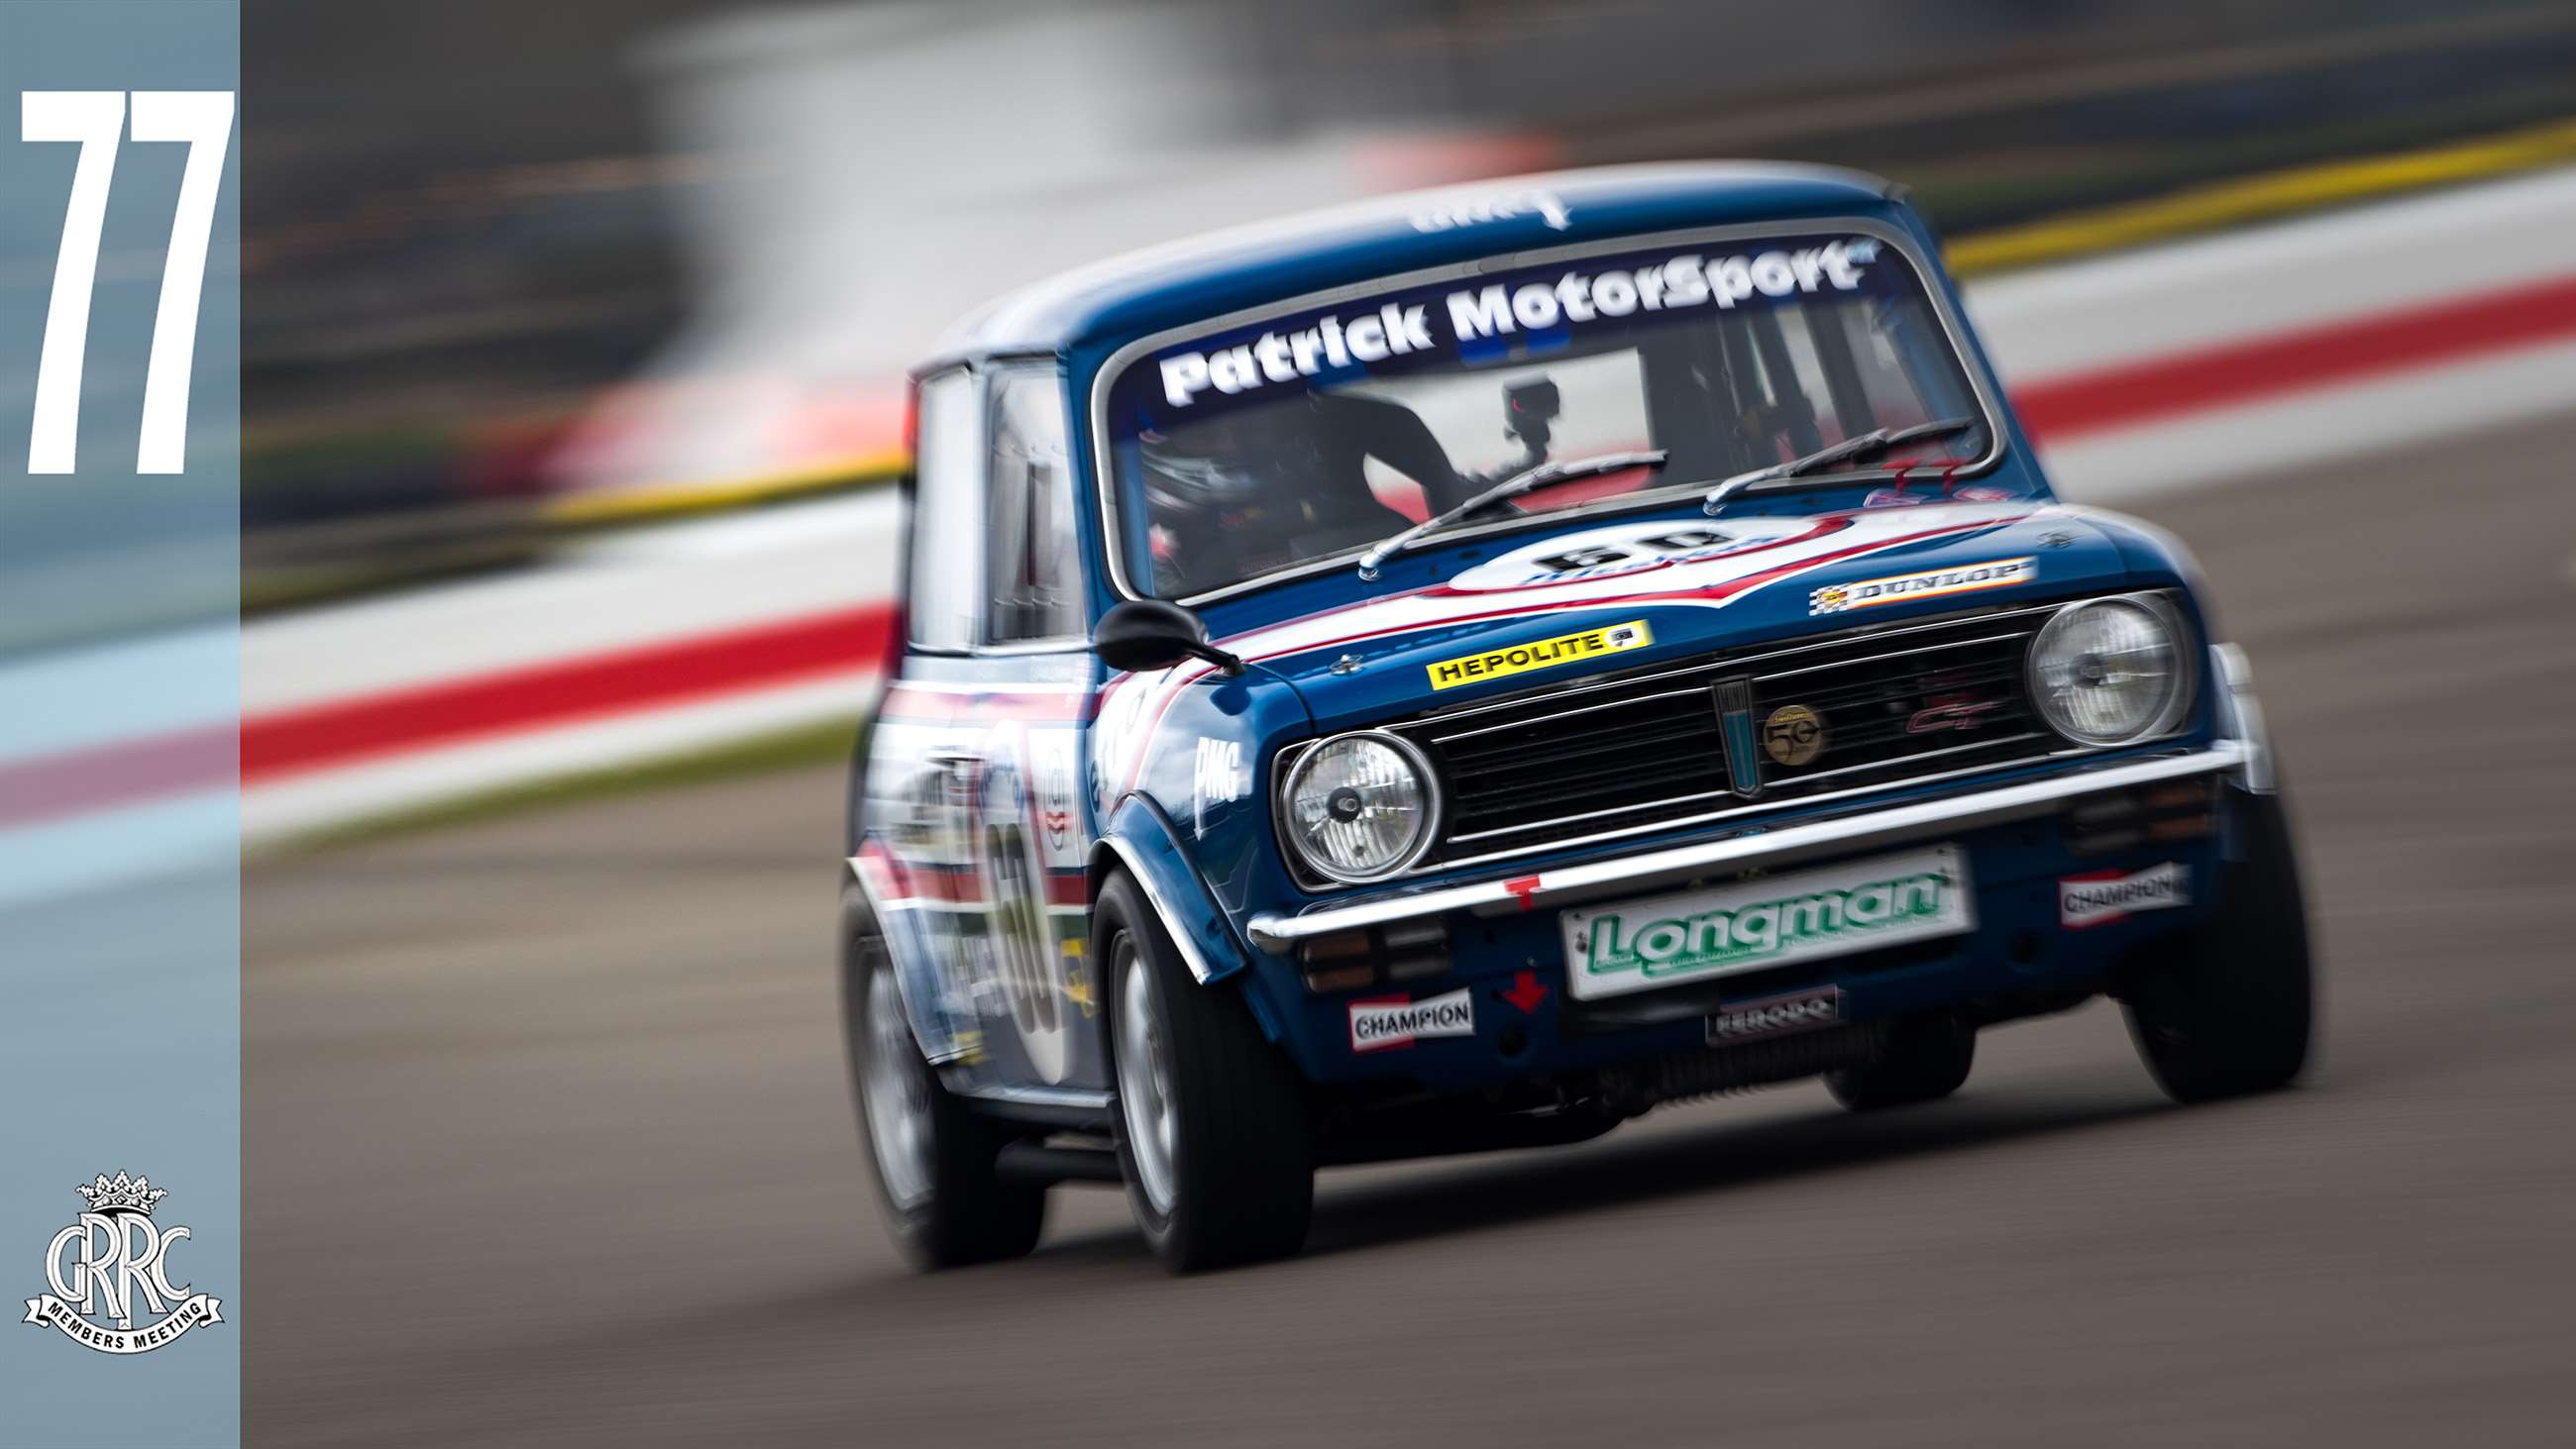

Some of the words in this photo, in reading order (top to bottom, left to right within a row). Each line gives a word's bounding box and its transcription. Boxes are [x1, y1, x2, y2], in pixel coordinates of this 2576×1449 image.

[1159, 303, 1436, 407] Patrick
[1854, 564, 2018, 600] DUNLOP
[1438, 633, 1604, 681] HEPOLITE
[1194, 736, 1240, 840] PMG
[2064, 875, 2173, 912] CHAMPION
[1587, 874, 1950, 977] Longman
[1354, 1002, 1469, 1040] CHAMPION
[1716, 999, 1833, 1036] FERODO
